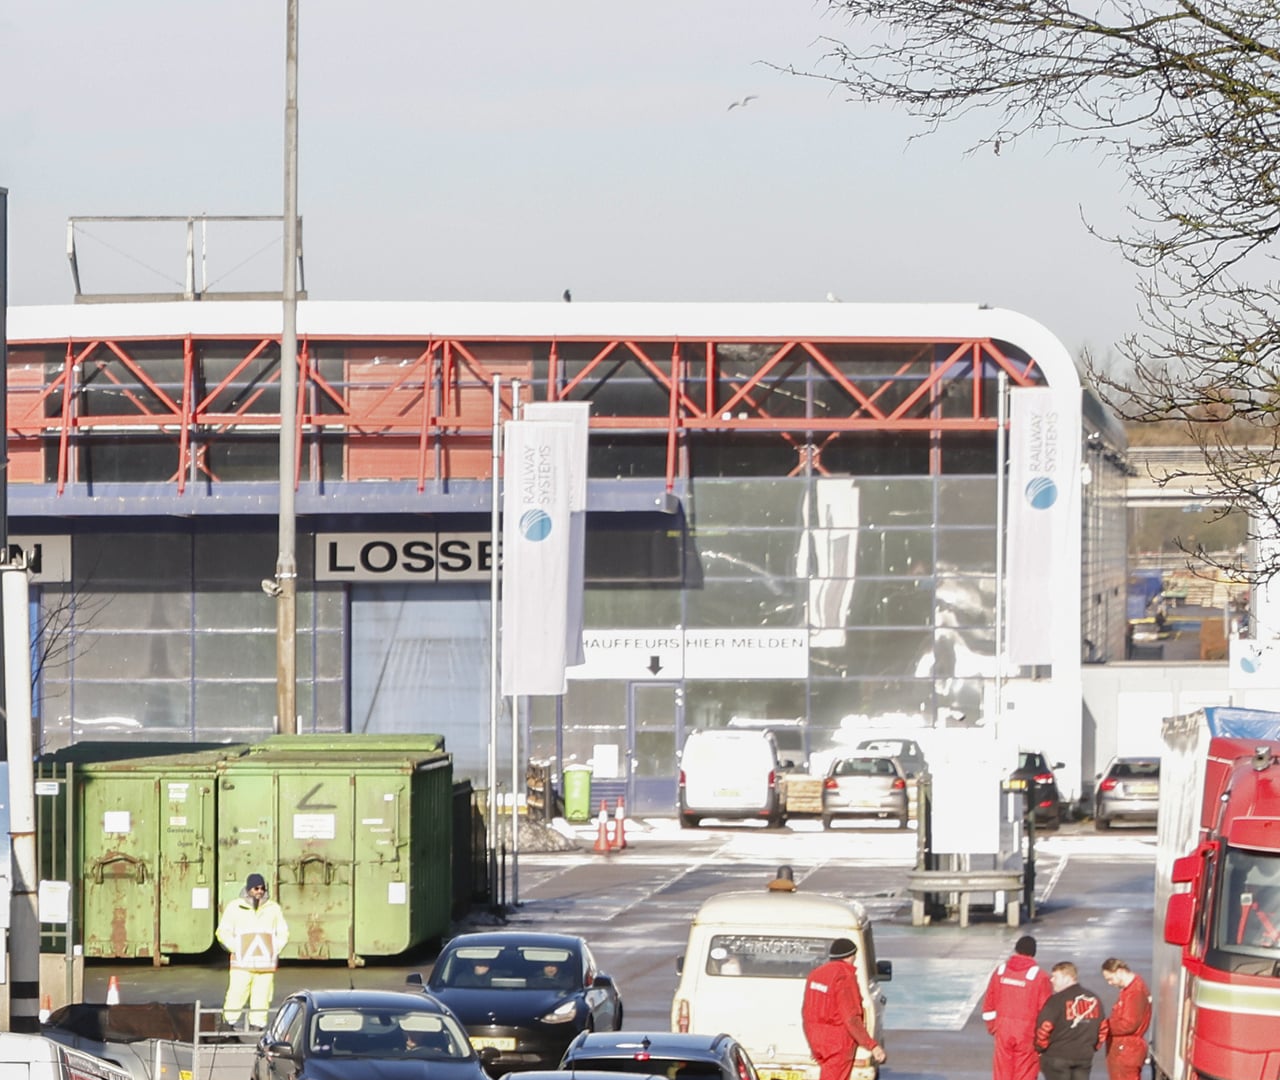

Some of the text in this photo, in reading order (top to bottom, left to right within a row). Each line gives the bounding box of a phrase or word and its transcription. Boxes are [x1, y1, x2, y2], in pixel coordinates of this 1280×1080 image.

[1029, 411, 1042, 472] RAILWAY
[1044, 410, 1058, 473] SYSTEMS
[523, 445, 536, 504] RAILWAY
[538, 444, 551, 505] SYSTEMS
[686, 638, 725, 649] HIER
[731, 638, 804, 649] MELDEN
